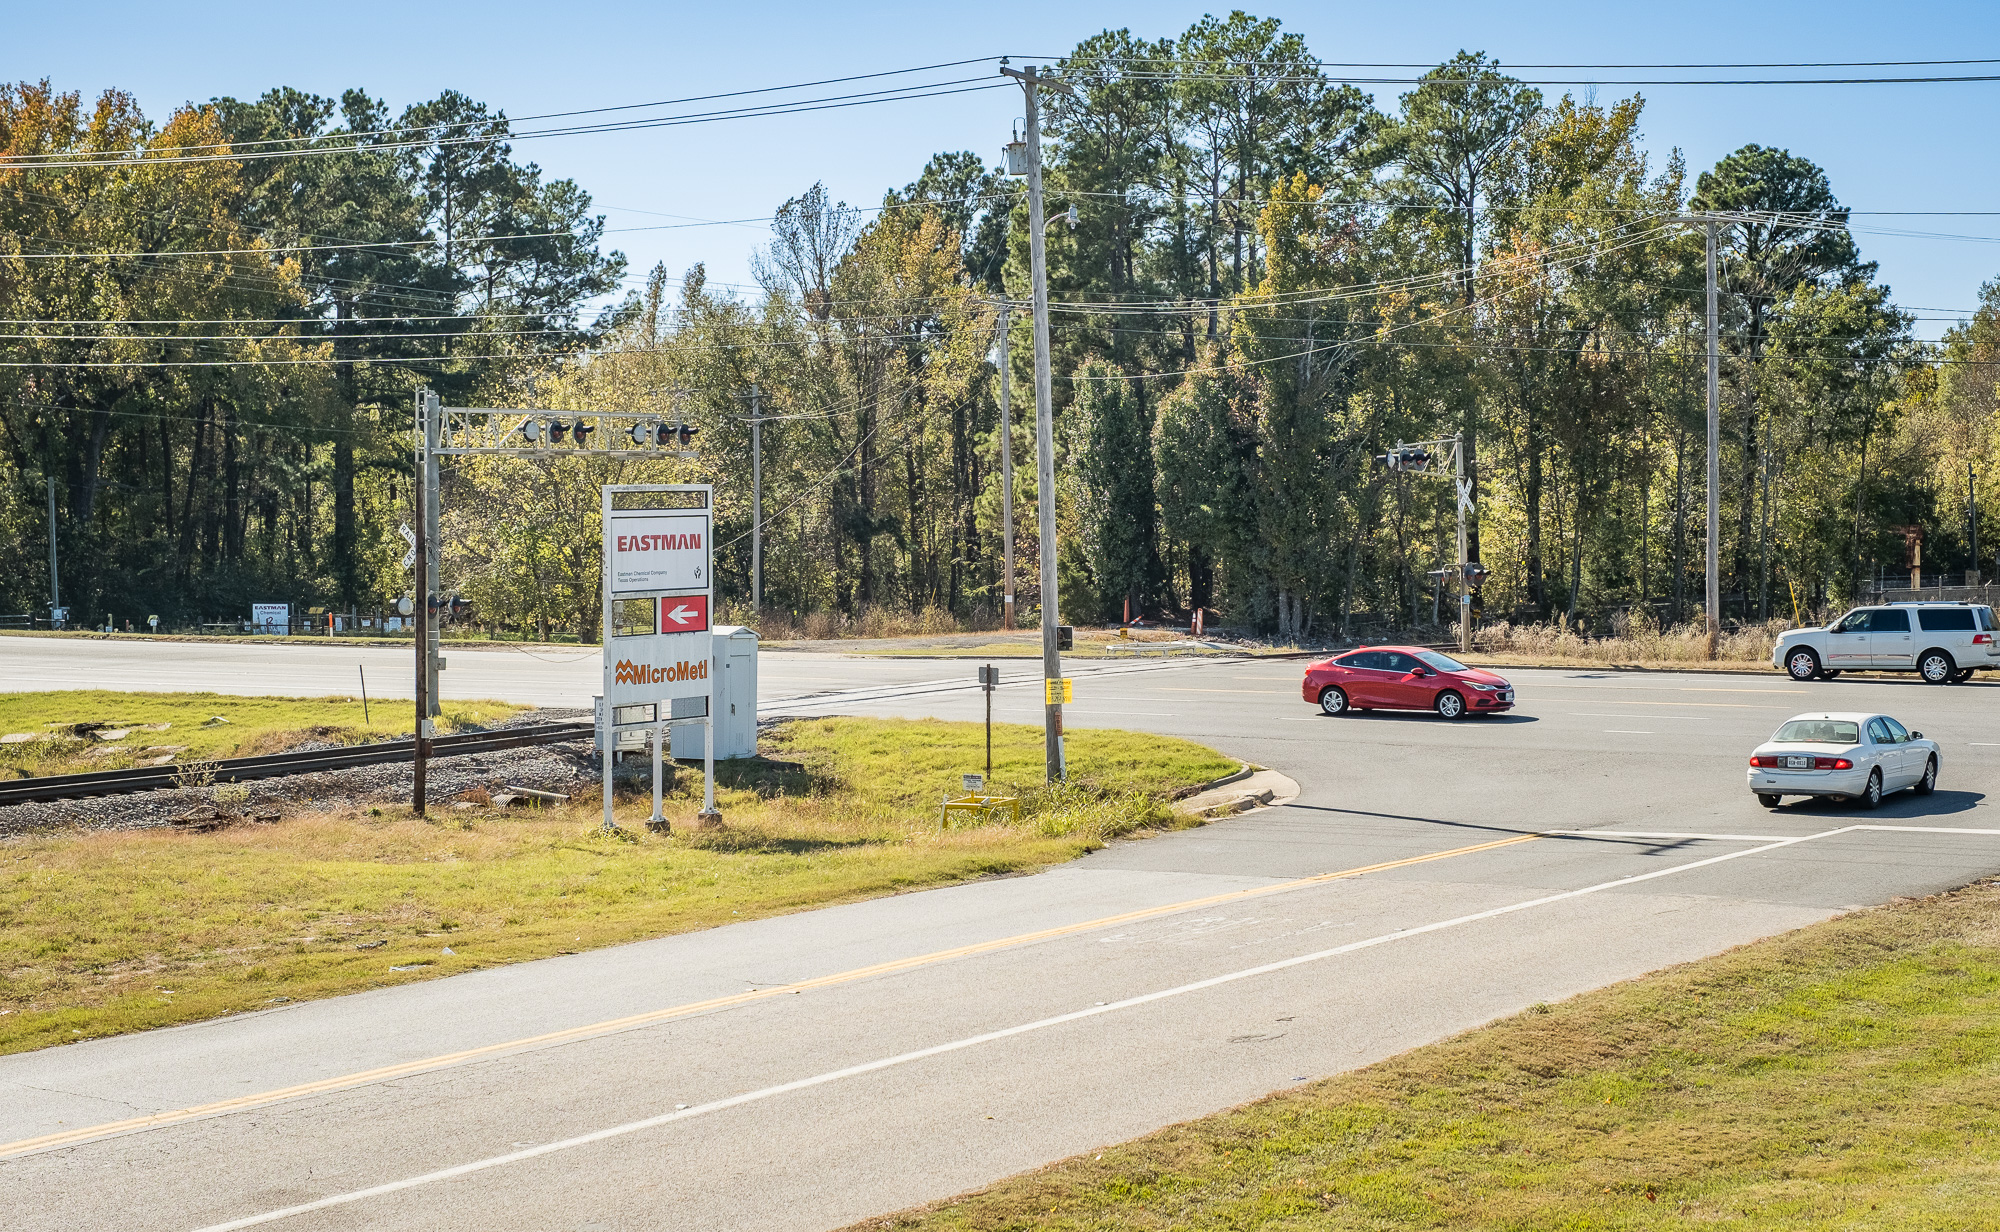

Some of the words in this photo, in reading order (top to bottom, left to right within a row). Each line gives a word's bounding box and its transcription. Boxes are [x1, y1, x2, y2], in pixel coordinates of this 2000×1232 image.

[401, 525, 415, 545] RAIL
[617, 534, 702, 552] EASTMAN
[633, 659, 708, 686] MicroMetl
